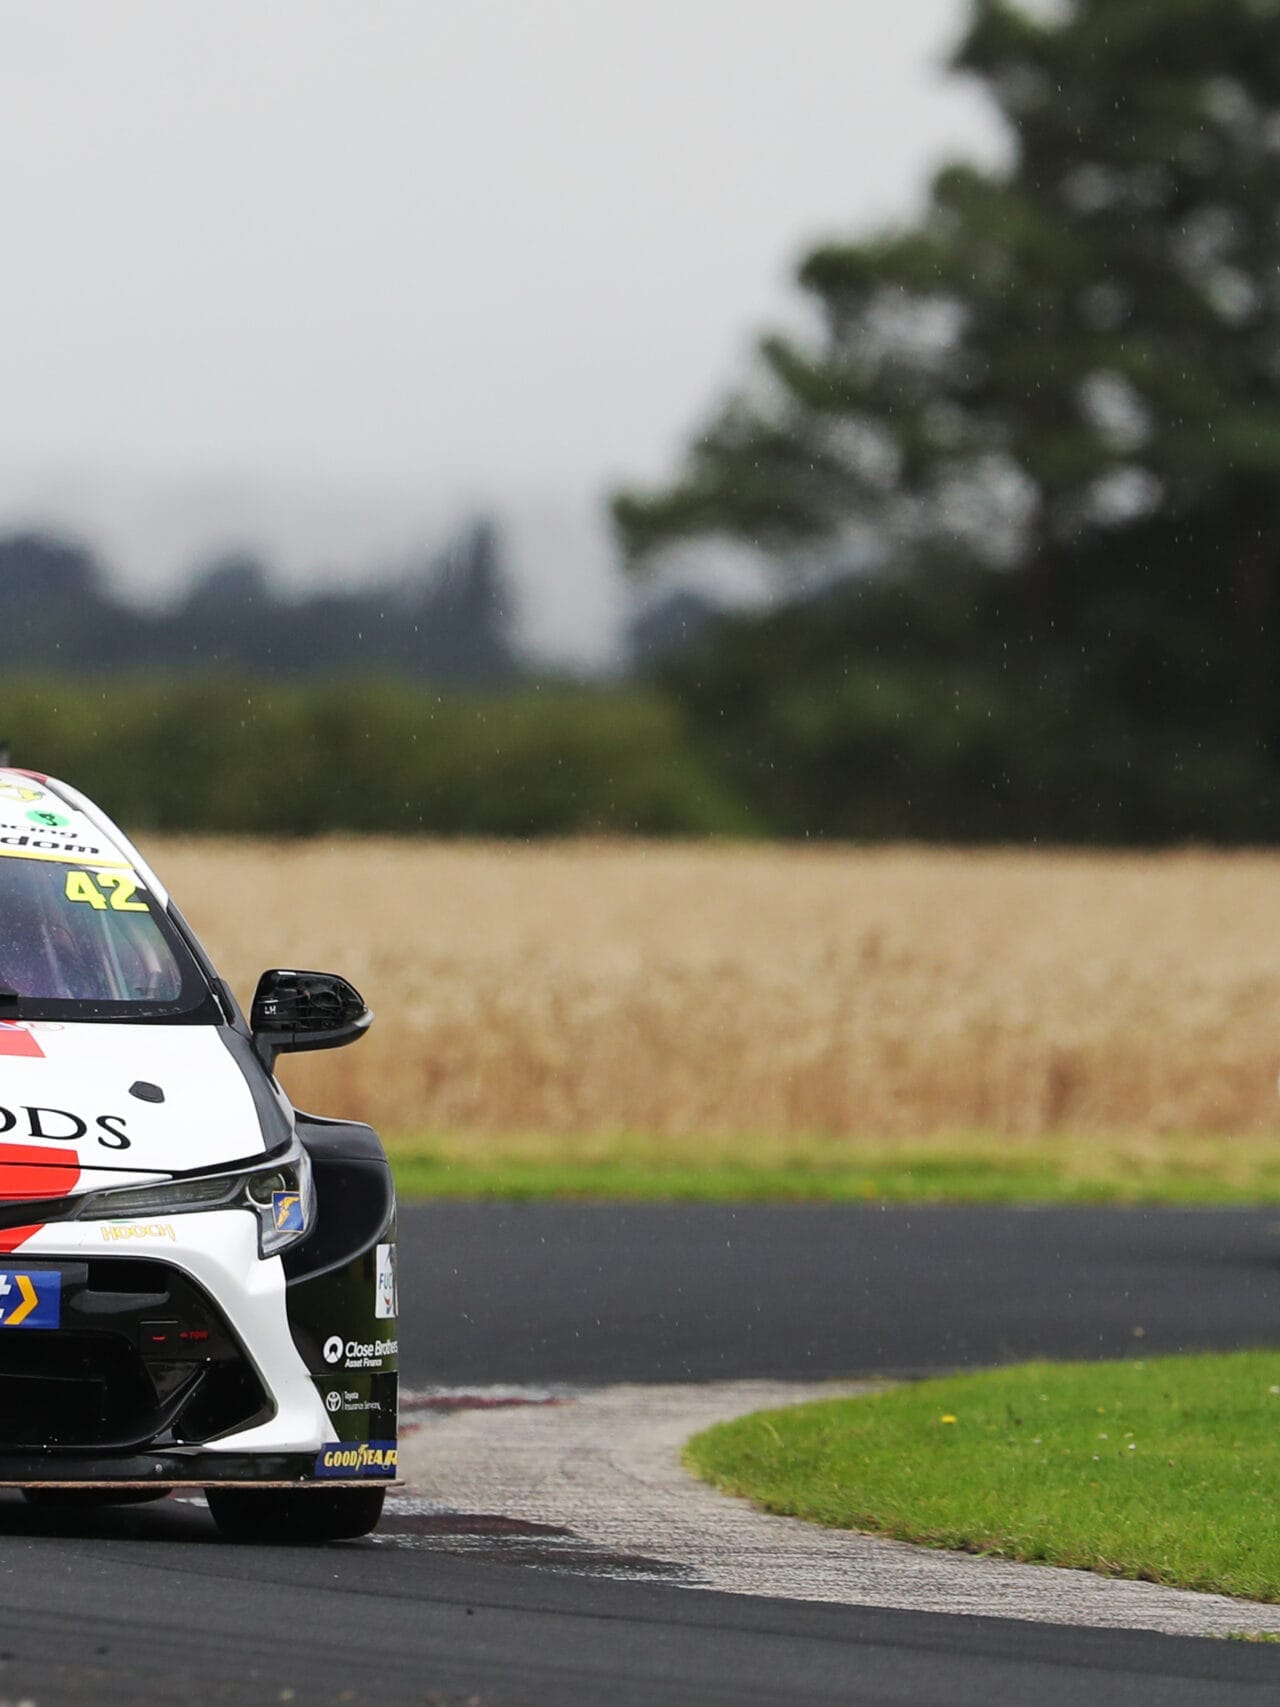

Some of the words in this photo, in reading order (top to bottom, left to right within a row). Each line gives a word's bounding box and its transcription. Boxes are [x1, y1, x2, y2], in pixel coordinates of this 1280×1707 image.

[65, 871, 150, 912] 42
[100, 1223, 176, 1242] HOOCH
[345, 1341, 374, 1357] Close
